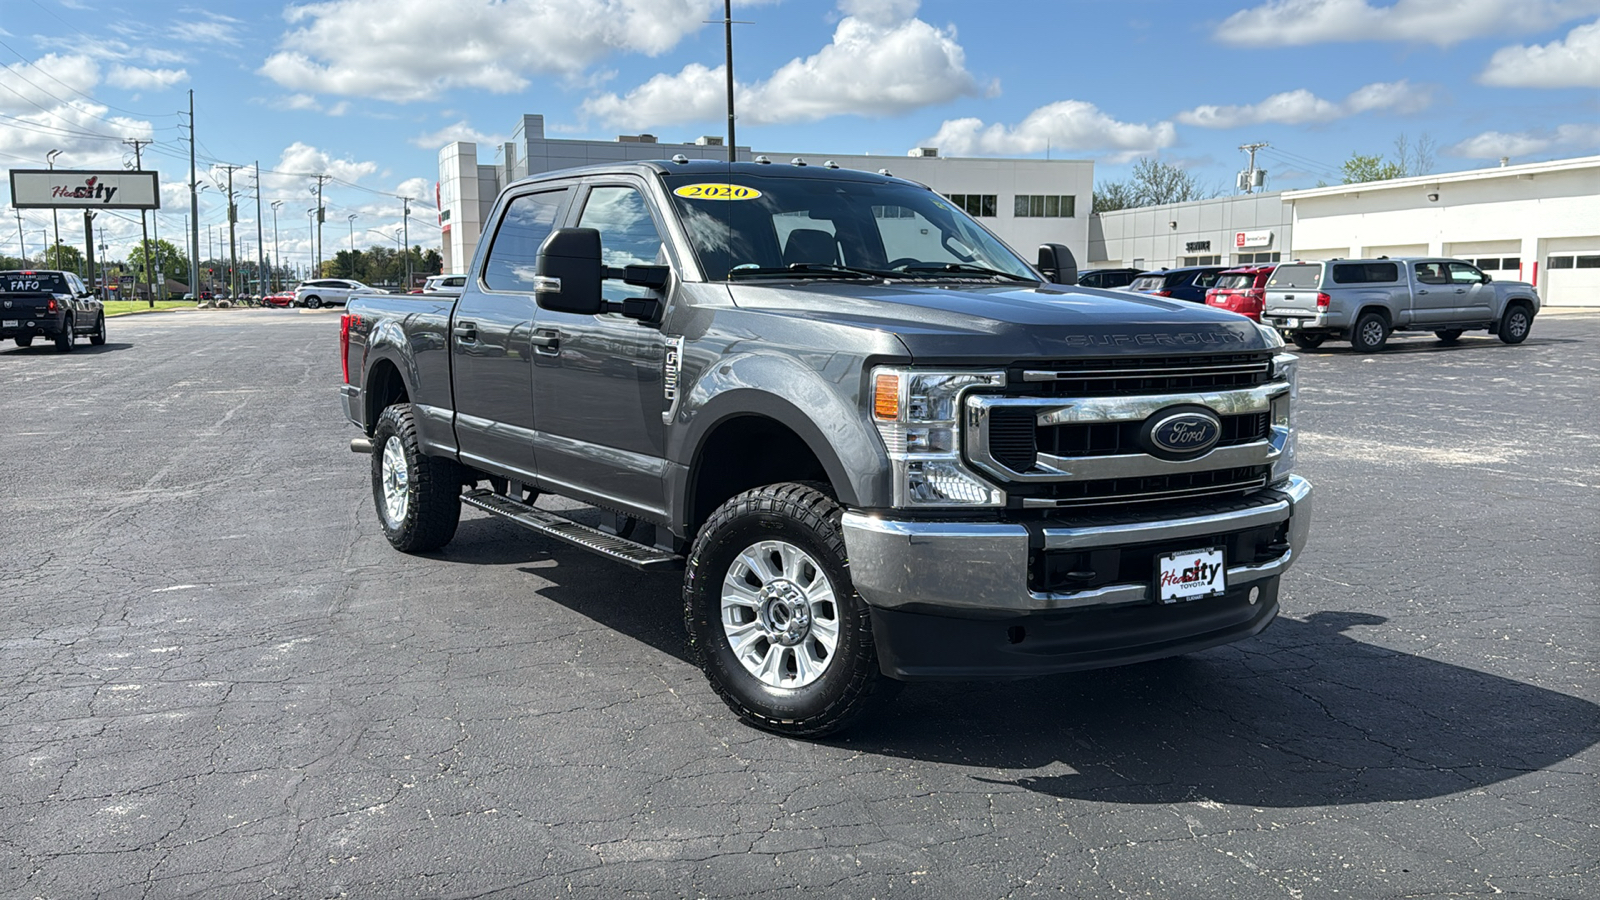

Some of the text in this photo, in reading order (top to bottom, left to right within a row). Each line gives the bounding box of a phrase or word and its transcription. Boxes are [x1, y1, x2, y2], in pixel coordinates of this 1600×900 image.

[74, 180, 118, 203] city
[688, 186, 749, 197] 2020
[10, 280, 40, 291] FAFO
[1065, 331, 1245, 347] SUPER DUTY
[1169, 420, 1206, 444] Ford
[1182, 561, 1221, 586] city
[1180, 581, 1206, 590] TOYOTA
